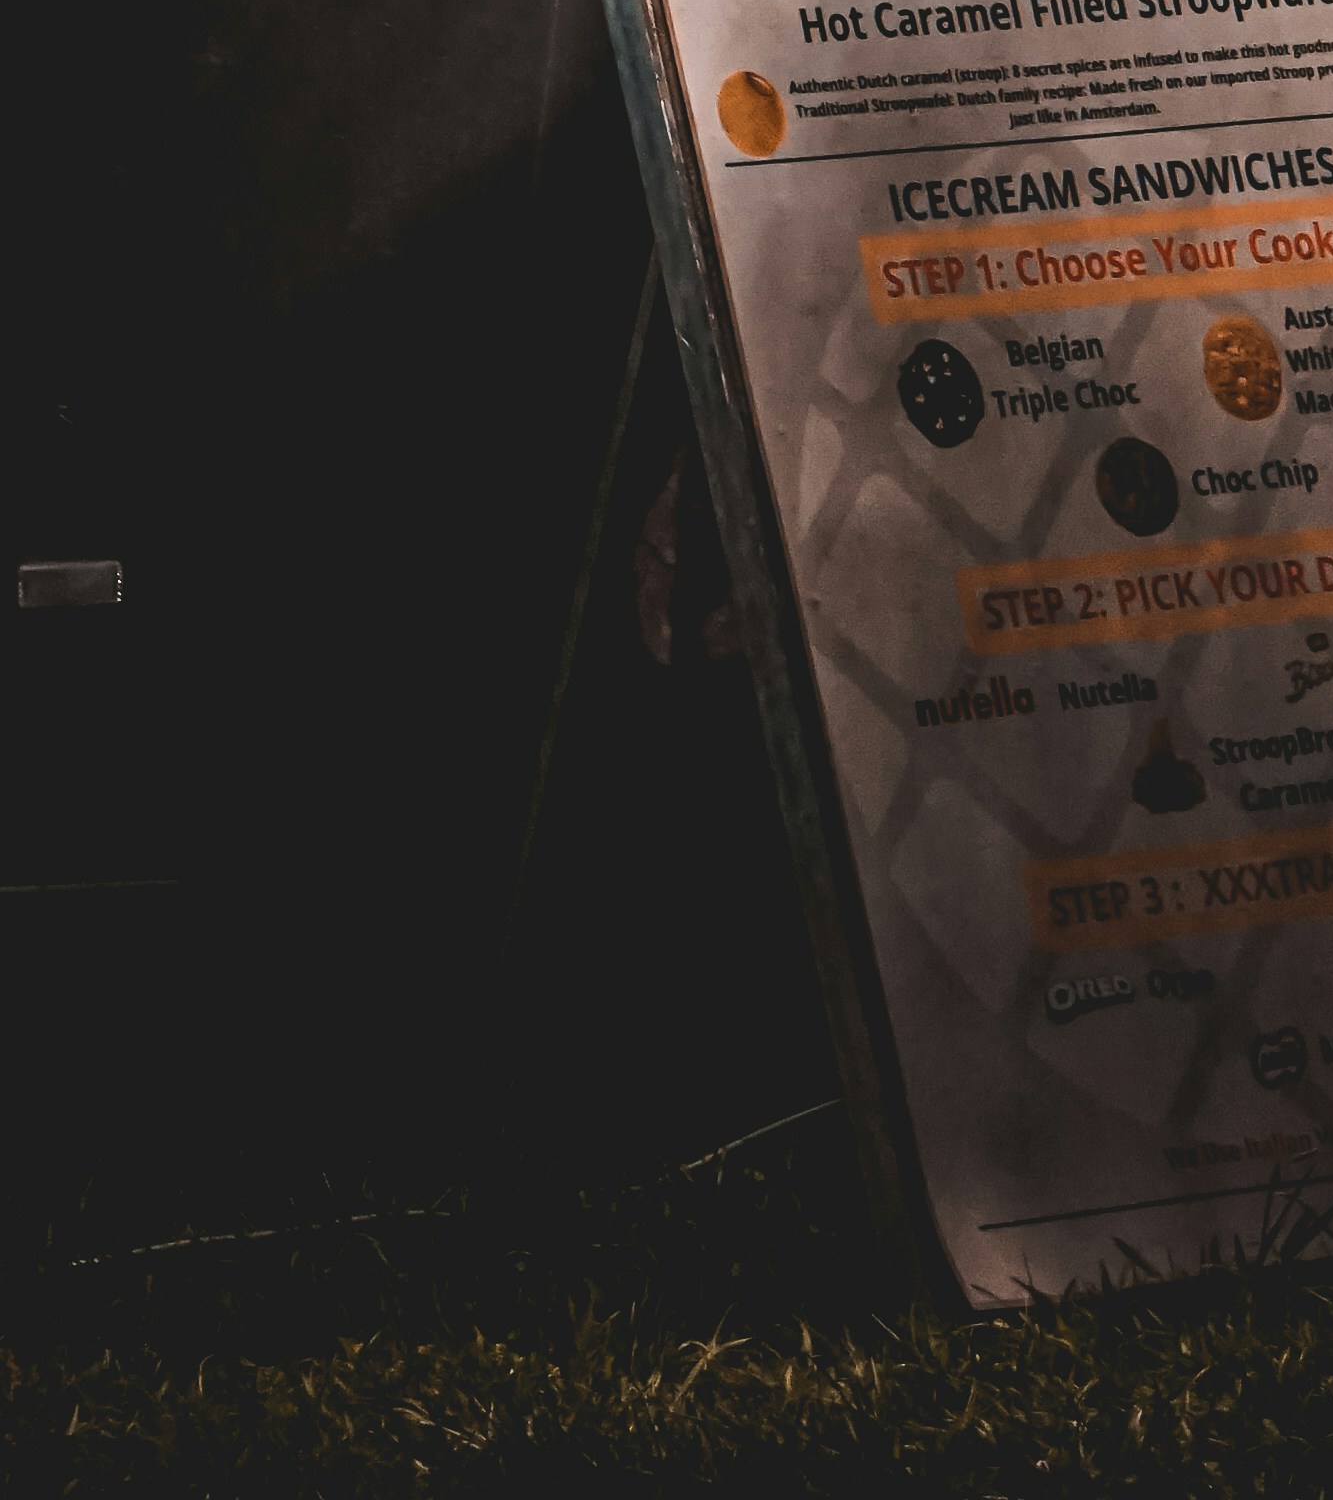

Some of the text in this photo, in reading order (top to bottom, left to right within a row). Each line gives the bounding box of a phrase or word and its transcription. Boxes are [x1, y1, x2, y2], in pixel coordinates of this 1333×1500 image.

[799, 5, 869, 44] Hot
[788, 77, 855, 95] Authentic
[857, 72, 897, 90] Dutch
[900, 68, 952, 86] caramel
[1022, 62, 1065, 77] secret
[1066, 58, 1108, 78] spices
[1109, 57, 1131, 71] are
[1132, 50, 1182, 69] infused
[1185, 49, 1199, 64] to
[1202, 46, 1239, 63] make
[1241, 43, 1265, 59] this
[1268, 41, 1291, 57] hot
[795, 98, 869, 118] Traditional
[957, 89, 997, 106] Dutch
[998, 86, 1040, 105] family
[1088, 78, 1127, 96] Made
[1127, 76, 1163, 93] fresh
[1165, 76, 1183, 90] on
[1185, 72, 1208, 88] our
[1210, 67, 1270, 88] imported
[1273, 64, 1315, 82] Stroop
[1037, 106, 1062, 124] like
[1063, 106, 1078, 122] in
[1081, 101, 1161, 121] Amsterdam.
[888, 168, 1081, 222] ICECREAM
[882, 255, 966, 300] STEP
[974, 252, 1008, 292] 1:
[1014, 242, 1148, 288] Choose
[1151, 234, 1238, 276] Your
[1004, 333, 1104, 371] Belgian
[990, 379, 1141, 424] Triple Choc
[1190, 458, 1319, 497] Choc Chip
[980, 583, 1064, 631] STEP
[1072, 581, 1108, 621] 2:
[1114, 570, 1200, 617] PICK
[1204, 558, 1310, 603] YOUR
[915, 674, 1036, 728] nutella
[1057, 671, 1159, 712] Nutella
[1047, 880, 1131, 928] STEP
